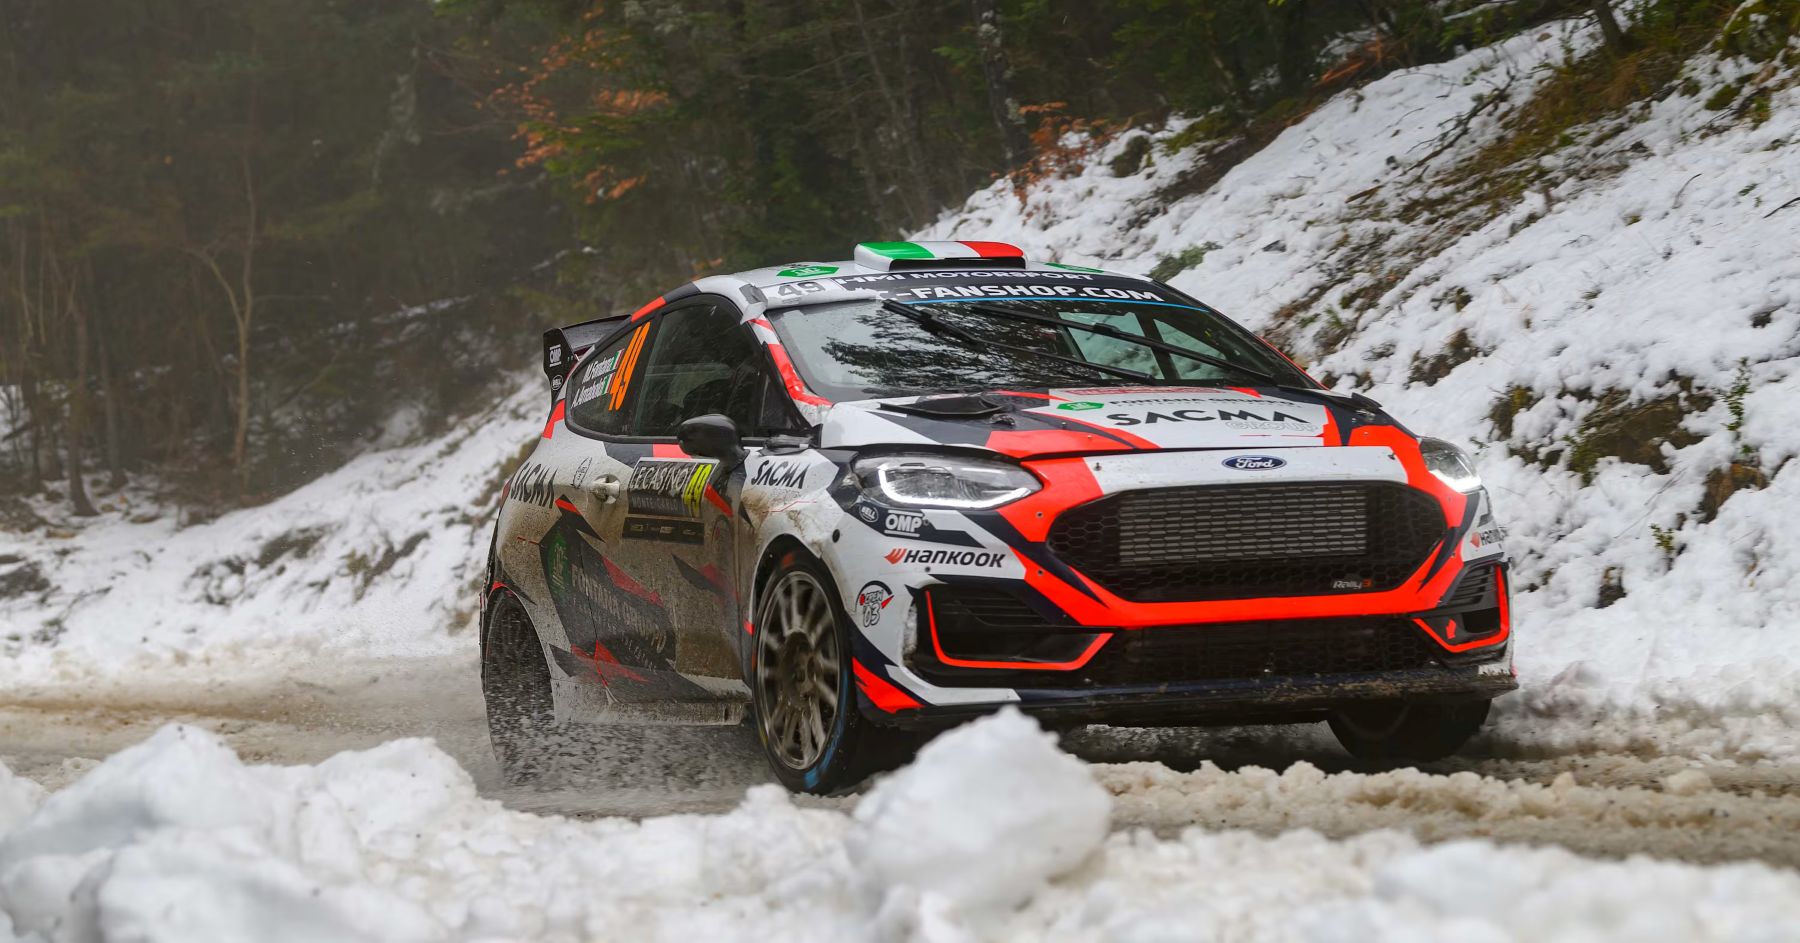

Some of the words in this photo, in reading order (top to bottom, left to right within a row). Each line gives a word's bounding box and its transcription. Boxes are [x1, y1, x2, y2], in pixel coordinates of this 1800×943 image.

[910, 272, 1094, 281] MOTORSPORT
[608, 321, 651, 411] 49
[1106, 409, 1310, 426] SACMA
[1235, 456, 1275, 470] Ford
[751, 459, 811, 489] SACMA
[510, 461, 560, 510] SACMA
[861, 506, 875, 519] BELL
[885, 513, 922, 533] OMP
